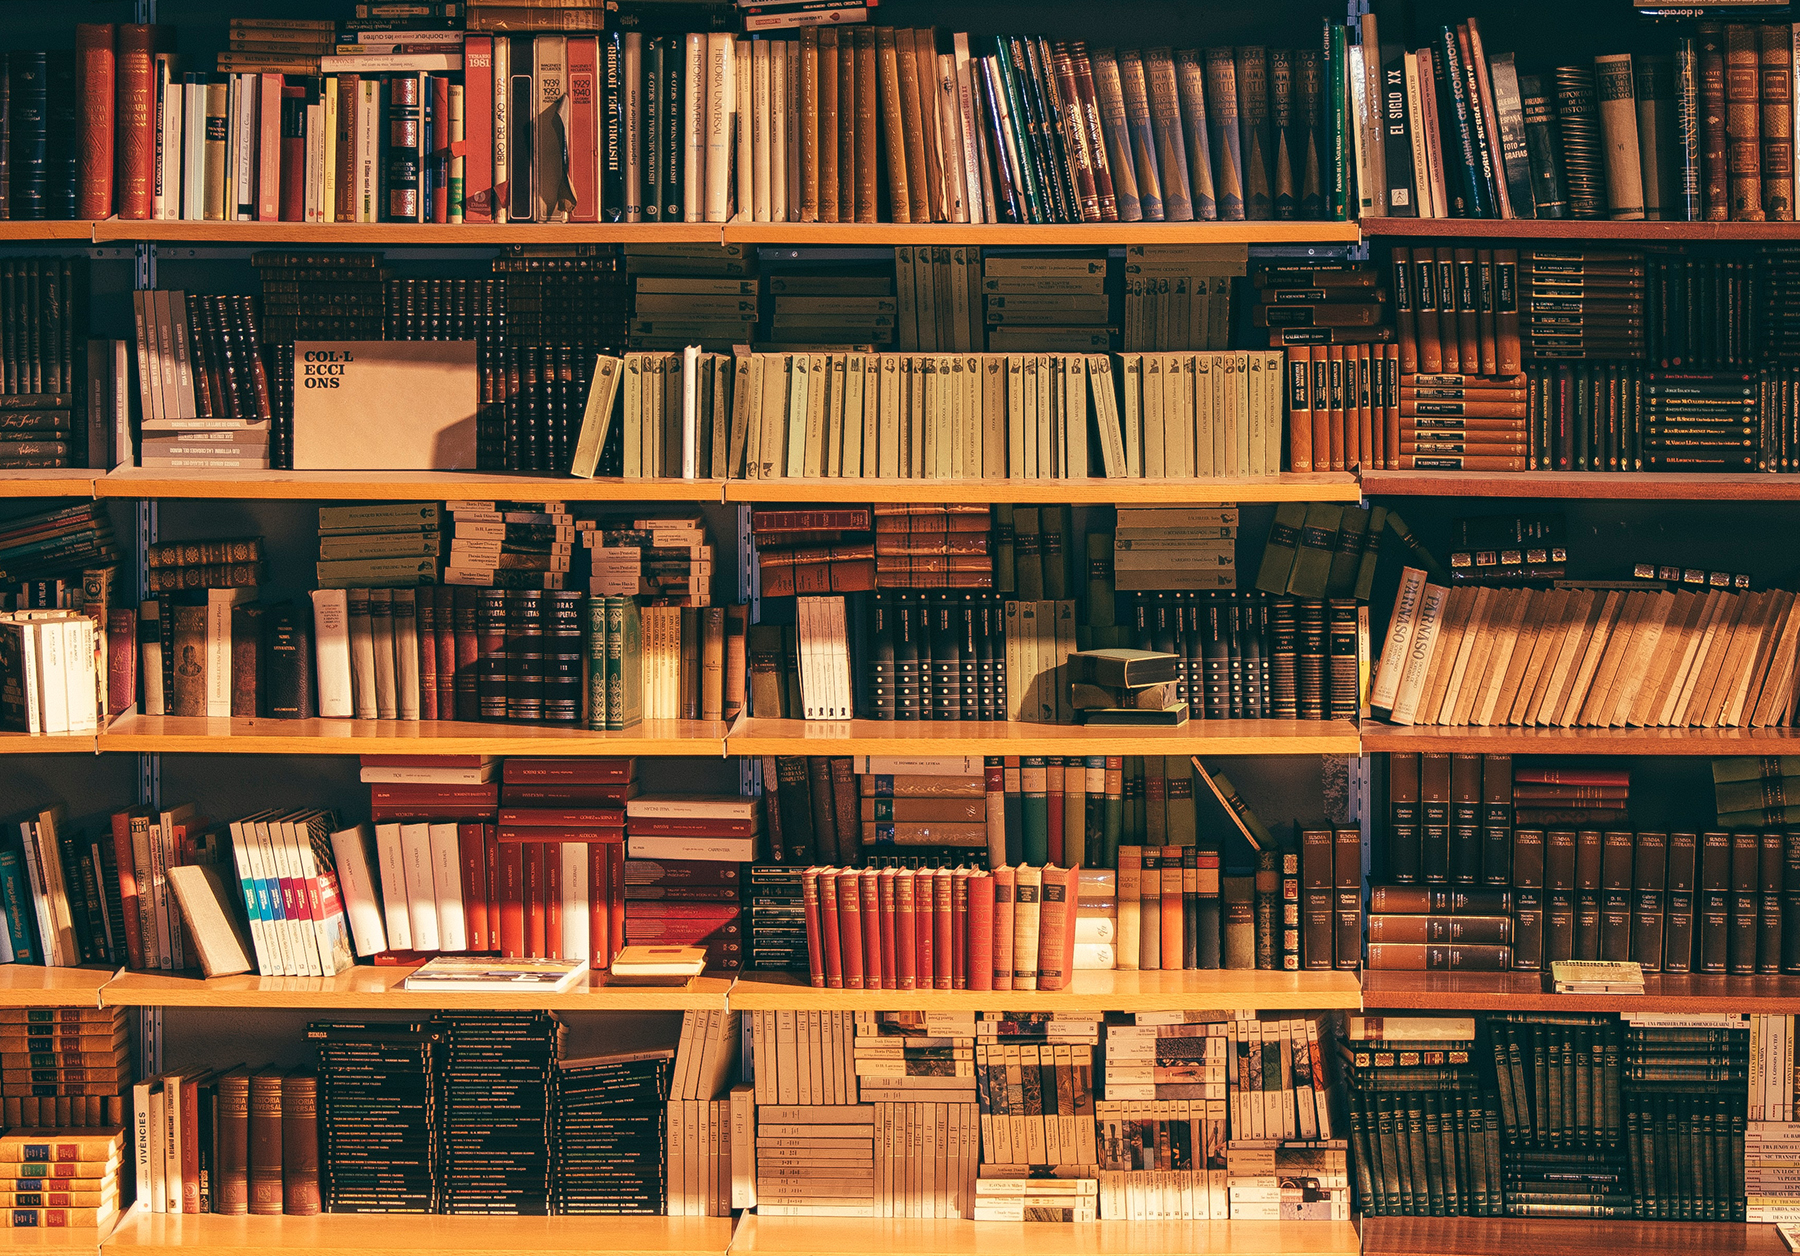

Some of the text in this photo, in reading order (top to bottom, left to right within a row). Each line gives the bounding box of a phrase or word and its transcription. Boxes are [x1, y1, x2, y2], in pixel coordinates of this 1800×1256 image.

[1658, 9, 1704, 17] el dorado
[648, 41, 655, 51] 5
[1324, 49, 1330, 61] LA
[469, 58, 490, 68] 1981
[1444, 32, 1465, 100] SCOMPAIONO
[542, 78, 561, 88] 1939
[572, 79, 591, 88] 1929
[1466, 64, 1477, 90] GATA
[542, 87, 561, 96] 1950
[572, 88, 591, 97] 1940
[692, 49, 702, 136] HISTORIA UNIVERSAL
[713, 48, 723, 136] HISTORIA UNIVERSAL
[1387, 69, 1404, 135] EL SIGLO XX
[1471, 92, 1479, 104] DE
[1495, 87, 1504, 96] LA
[607, 41, 619, 171] HISTORIA DEL HOMBRE
[1456, 101, 1467, 121] CHE
[1497, 98, 1519, 108] GUERRA
[156, 102, 164, 130] ANIMALES
[495, 77, 506, 166] LIBRO DEL AÑO 1972
[1473, 106, 1485, 139] SIERRA
[1499, 114, 1521, 124] ESPAÑA
[629, 89, 638, 166] Sapientia Melior Auro
[647, 71, 655, 185] HISTORIA MUNDIAL DEL SIGLO 20
[1501, 125, 1509, 133] EN
[156, 144, 163, 154] DE
[1414, 131, 1423, 167] CATALANES
[1459, 123, 1475, 166] ANIMALI
[1504, 149, 1528, 160] GRAFIAS
[155, 155, 163, 185] CONDUCTA
[1480, 150, 1491, 178] CORIA
[155, 186, 162, 194] LA
[1416, 168, 1425, 191] PLOMES
[346, 183, 354, 211] HISTORIA
[304, 350, 354, 363] COL·L
[304, 364, 346, 376] ECCI
[304, 377, 340, 389] ONS
[38, 582, 46, 607] DE VILAR
[1391, 577, 1420, 644] PARNASO
[1411, 594, 1441, 661] PARNASO
[138, 1112, 147, 1165] VIVÈNCIES
[200, 1169, 209, 1188] crisis
